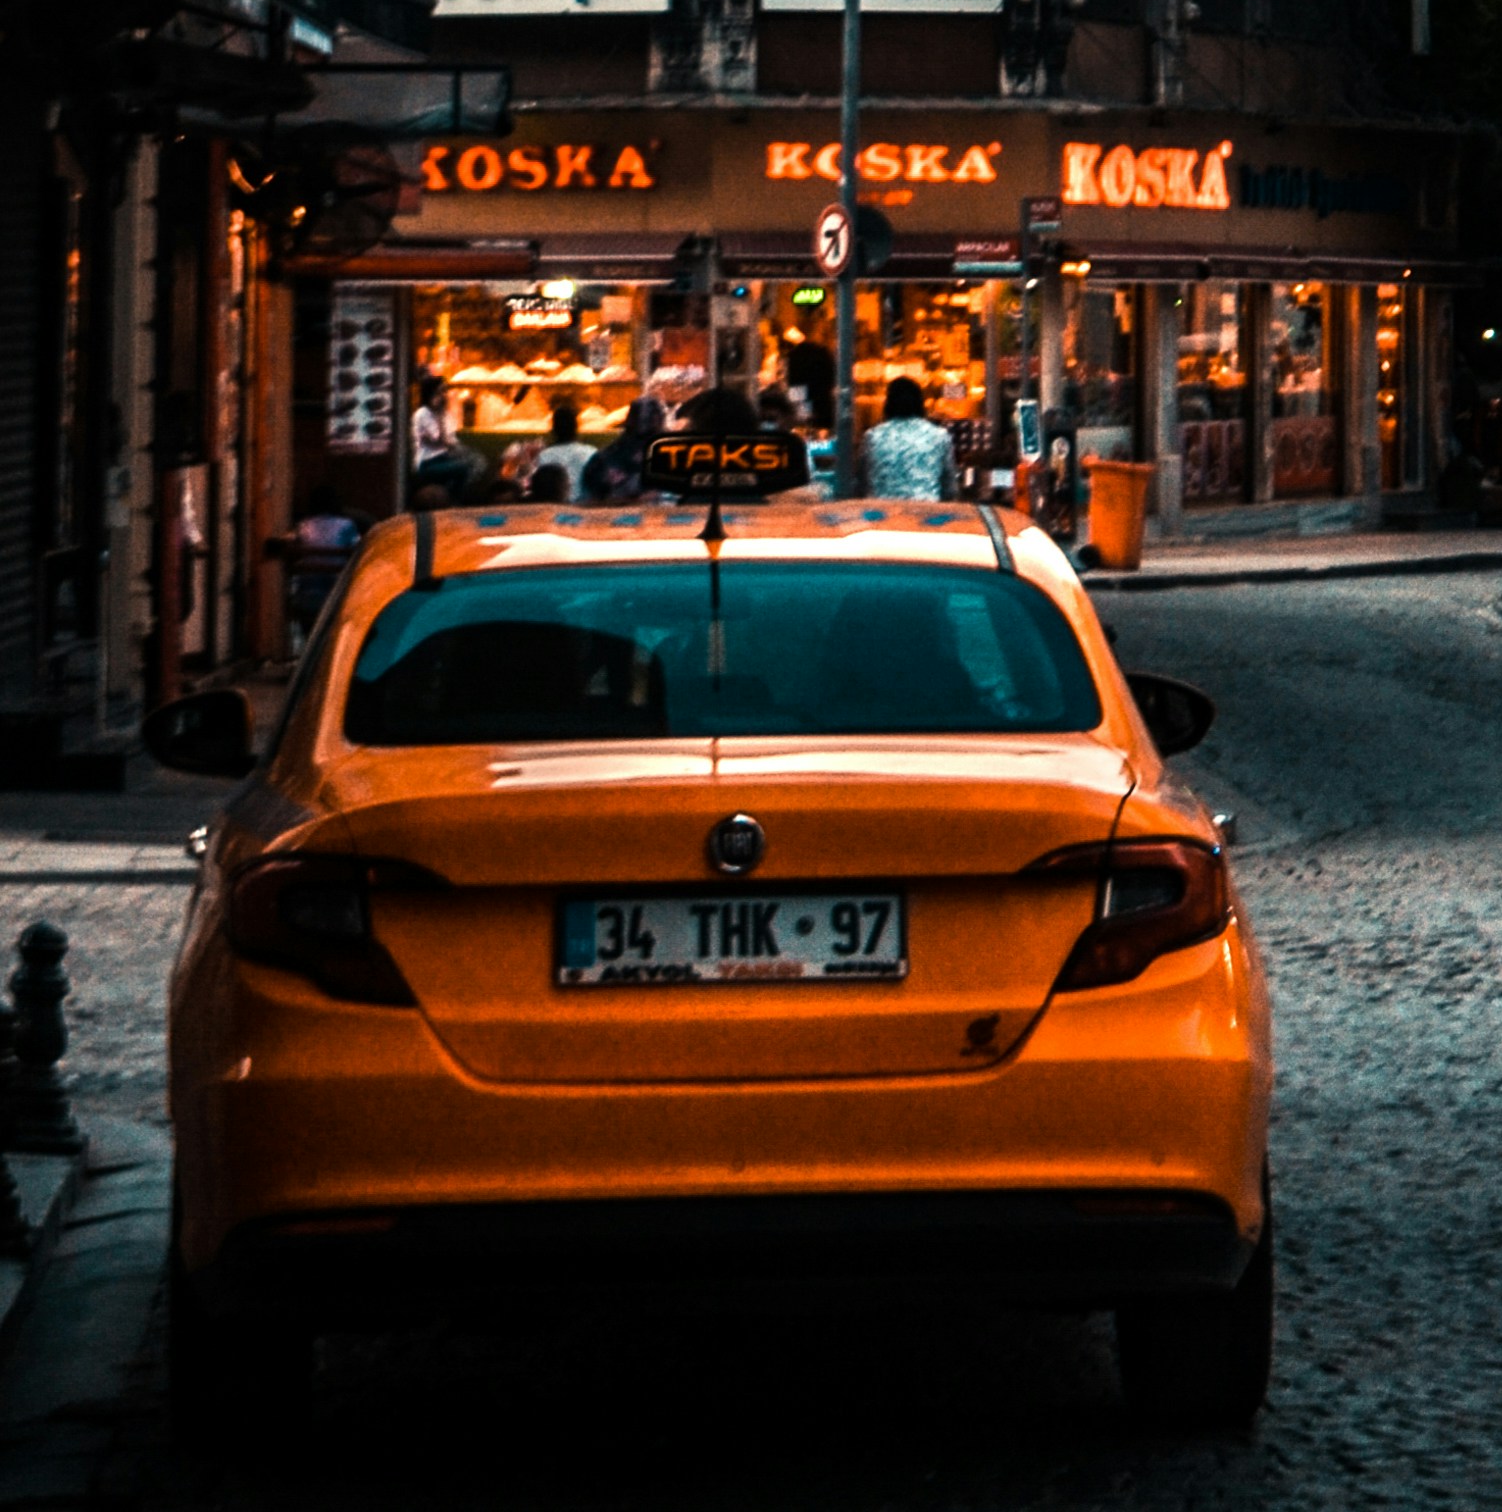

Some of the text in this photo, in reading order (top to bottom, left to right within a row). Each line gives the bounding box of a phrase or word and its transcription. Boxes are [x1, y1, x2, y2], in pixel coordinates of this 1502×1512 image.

[421, 144, 654, 191] KOSKA
[766, 142, 999, 183] KOSKA
[1062, 141, 1231, 210] KOSKA
[597, 900, 891, 960] 34 THK 97
